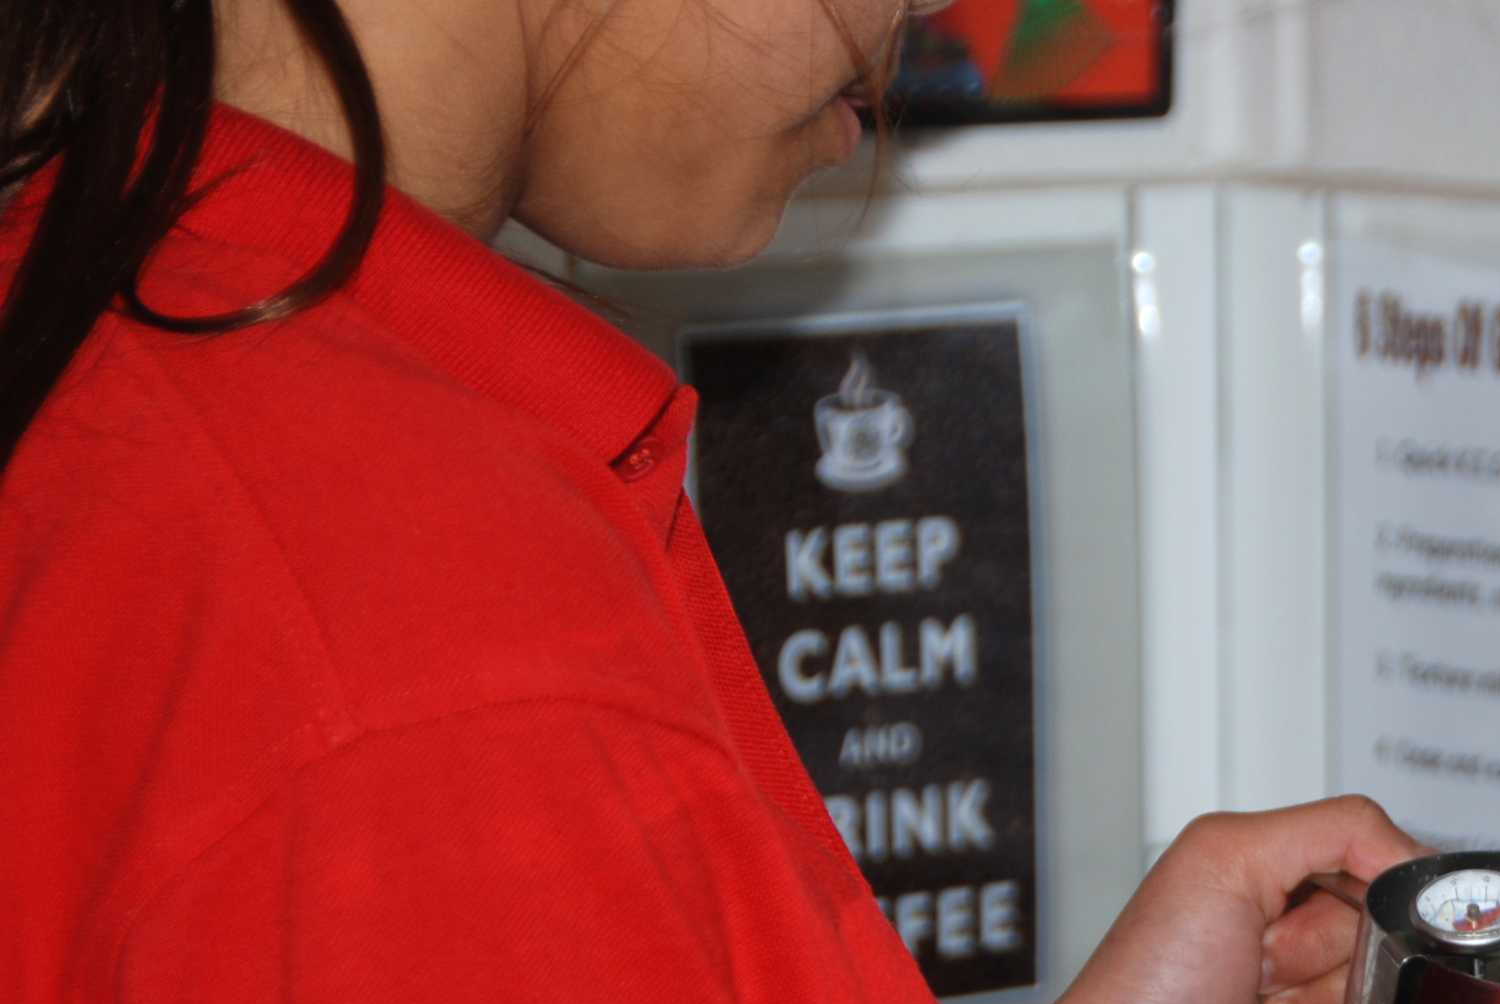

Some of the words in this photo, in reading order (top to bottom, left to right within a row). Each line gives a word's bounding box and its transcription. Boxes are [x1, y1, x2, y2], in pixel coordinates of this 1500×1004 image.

[784, 514, 959, 602] KEEP
[777, 612, 977, 704] CALM
[838, 721, 923, 769] AND
[822, 778, 994, 862] RINK
[876, 880, 1021, 957] FEE
